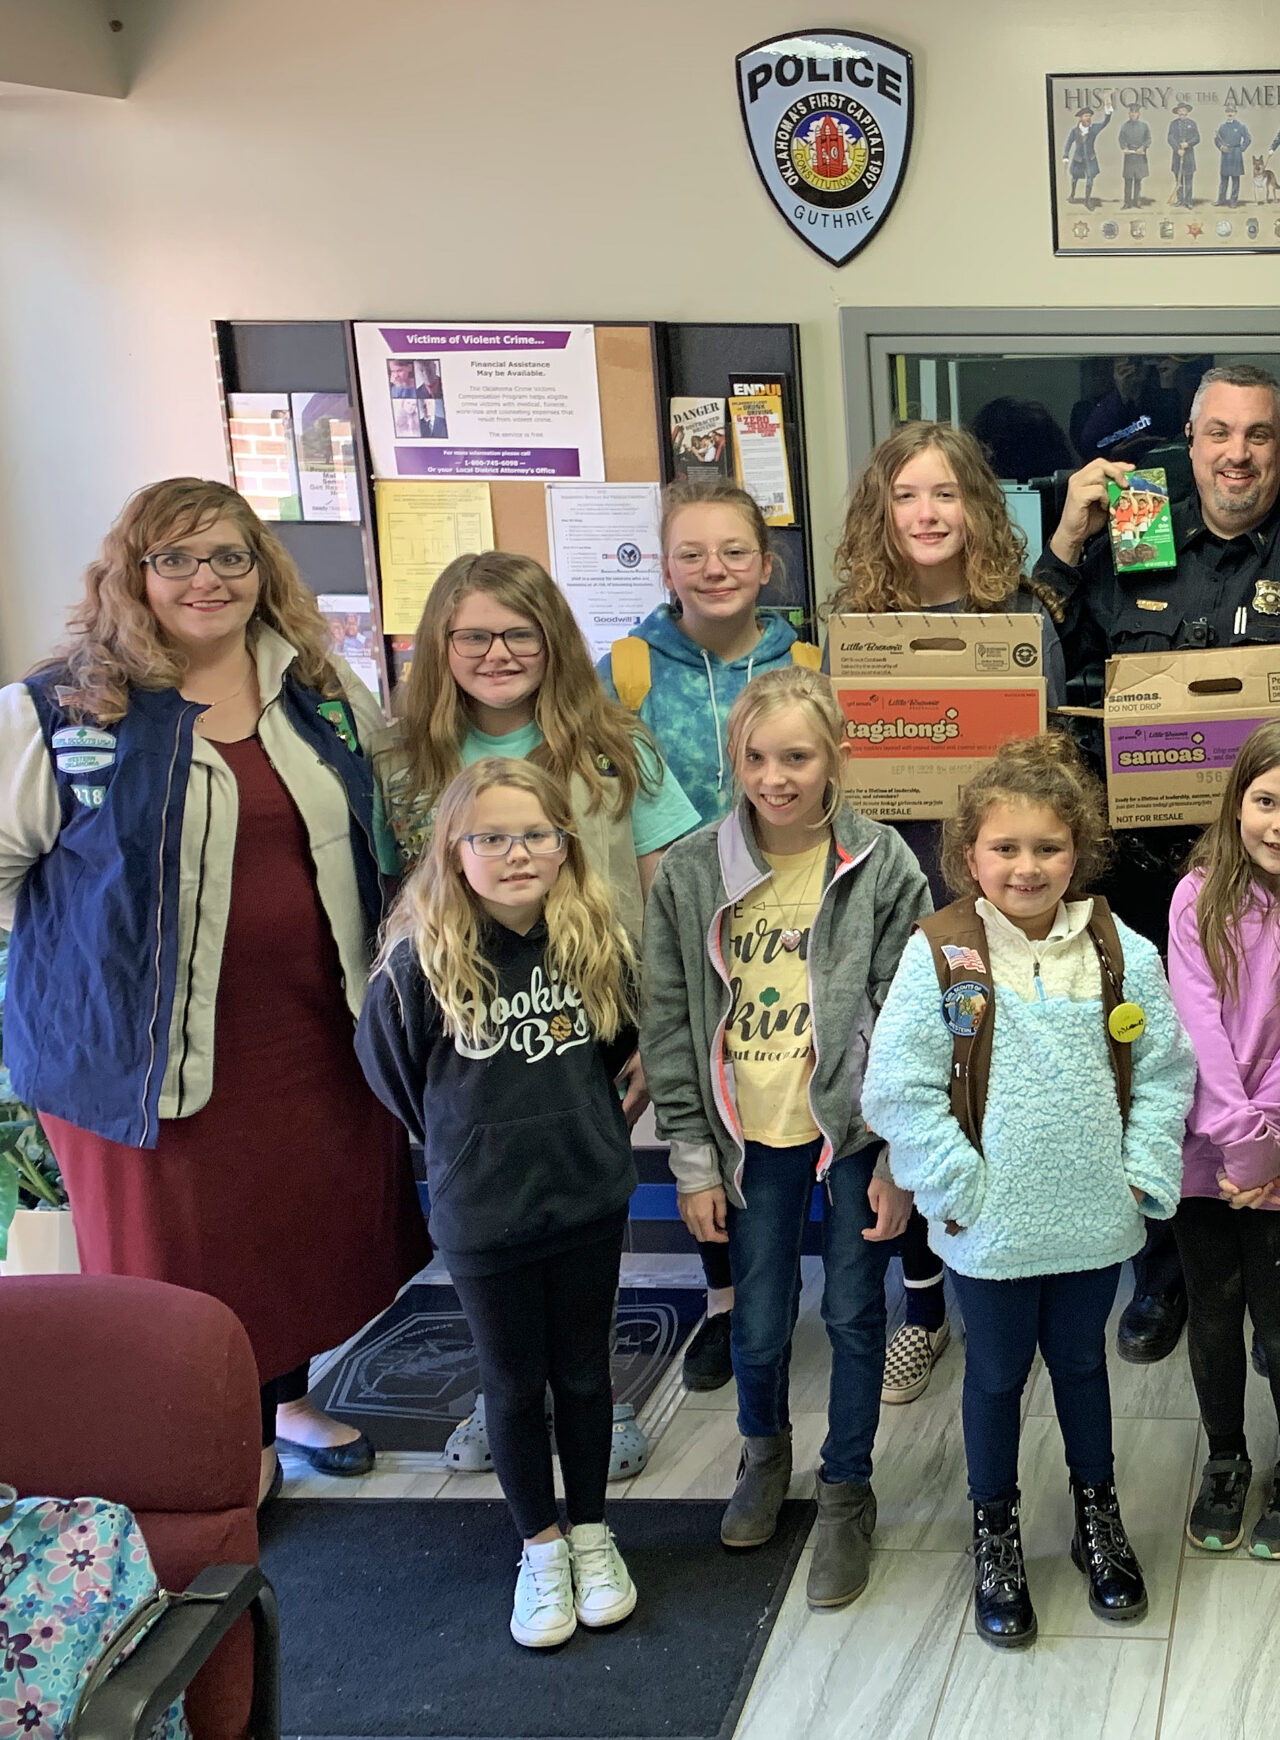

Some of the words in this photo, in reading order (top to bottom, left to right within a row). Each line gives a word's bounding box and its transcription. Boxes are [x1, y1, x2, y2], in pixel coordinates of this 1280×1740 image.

[748, 54, 902, 106] POLICE
[808, 94, 846, 109] FIRST
[1063, 86, 1172, 109] HISTORY
[1175, 91, 1192, 102] OF
[1194, 91, 1218, 102] THE
[847, 101, 884, 153] CAPITAL
[776, 102, 807, 186] OKLAHOMA'S
[795, 152, 853, 190] CONSTITUTION
[852, 153, 866, 177] HALL
[862, 160, 883, 190] 1907
[794, 205, 874, 229] GUTHRIE
[406, 335, 447, 345] Victims
[449, 334, 460, 344] of
[463, 334, 501, 344] Violent
[503, 335, 545, 345] Crime...
[673, 402, 720, 424] DANGER
[840, 642, 863, 651] Little
[1122, 704, 1138, 712] NOT
[1140, 703, 1161, 711] DROP
[846, 718, 960, 743] tagalongs
[1118, 747, 1206, 767] samoas
[1196, 770, 1229, 784] 956
[1135, 814, 1151, 822] FOR
[1153, 813, 1184, 821] RESALE
[725, 977, 812, 1041] kin
